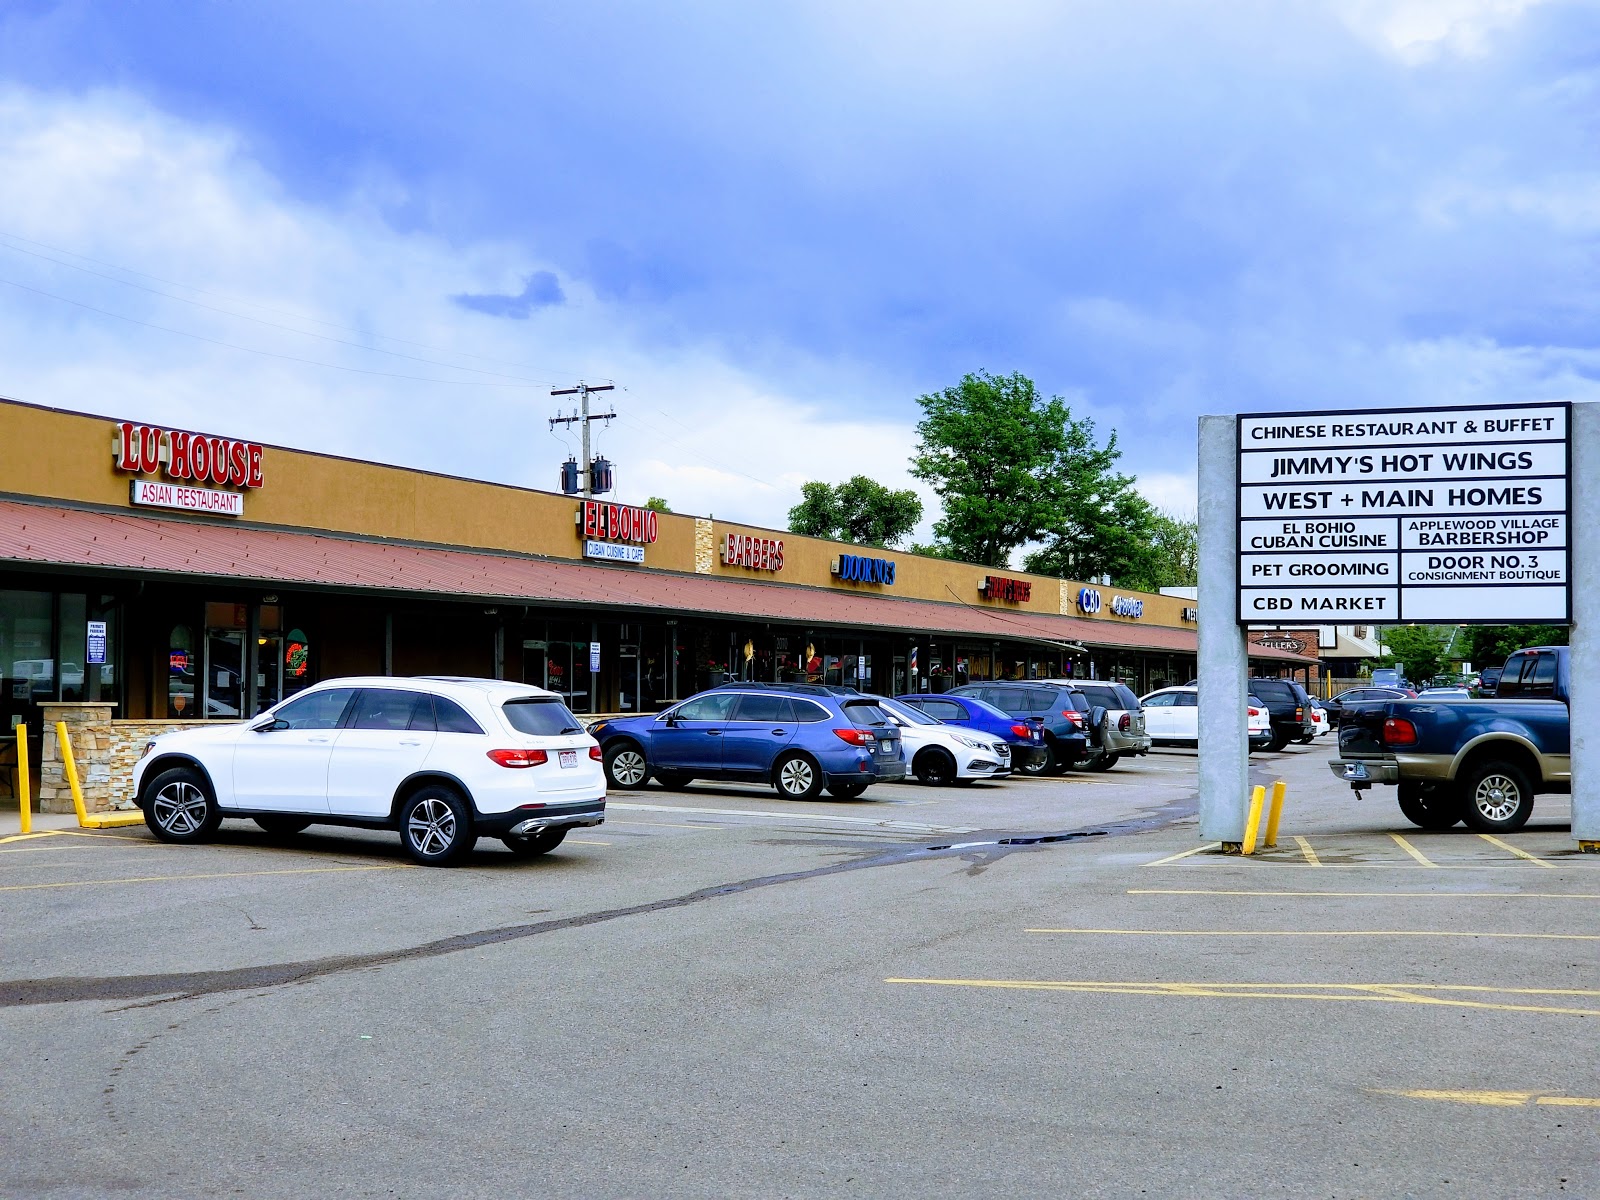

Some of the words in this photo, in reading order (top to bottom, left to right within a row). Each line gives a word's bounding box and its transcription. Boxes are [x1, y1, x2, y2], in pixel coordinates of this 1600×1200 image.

[1251, 425, 1327, 440] CHINESE
[1332, 421, 1457, 437] RESTAURANT
[1464, 420, 1478, 433] &
[1484, 417, 1555, 433] BUFFET
[118, 422, 162, 474] LU
[167, 431, 264, 488] HOUSE
[1270, 455, 1374, 478] JIMMY'S
[1381, 454, 1434, 473] HOT
[1442, 451, 1533, 471] WINGS
[141, 484, 172, 504] ASIAN
[177, 488, 239, 511] RESTAURANT
[1262, 491, 1333, 510] WEST
[1340, 493, 1354, 507] +
[1361, 489, 1434, 508] MAIN
[1448, 486, 1543, 506] HOMES
[583, 501, 606, 538] EL
[607, 505, 659, 544] BOHIO
[1283, 523, 1301, 534] EL
[1305, 522, 1356, 534] BOHIO
[1408, 520, 1496, 531] APPLEWOOD
[1500, 518, 1560, 529] VILLAGE
[1250, 535, 1314, 549] CUBAN
[1318, 534, 1387, 548] CUISINE
[1419, 530, 1549, 546] BARBERSHOP
[588, 543, 605, 556] CUBAN
[606, 545, 625, 559] CUISINE
[631, 548, 643, 561] CAFE
[725, 532, 784, 571] BARBERS
[841, 553, 872, 582] DOOR
[1252, 564, 1283, 577] PET
[1288, 562, 1389, 577] GROOMING
[1428, 556, 1485, 569] DOOR
[1408, 571, 1496, 580] CONSIGNMENT
[1499, 570, 1561, 580] BOUTIQUE
[1081, 587, 1102, 614] CBD
[1253, 597, 1293, 610] CBD
[1301, 597, 1386, 610] MARKET
